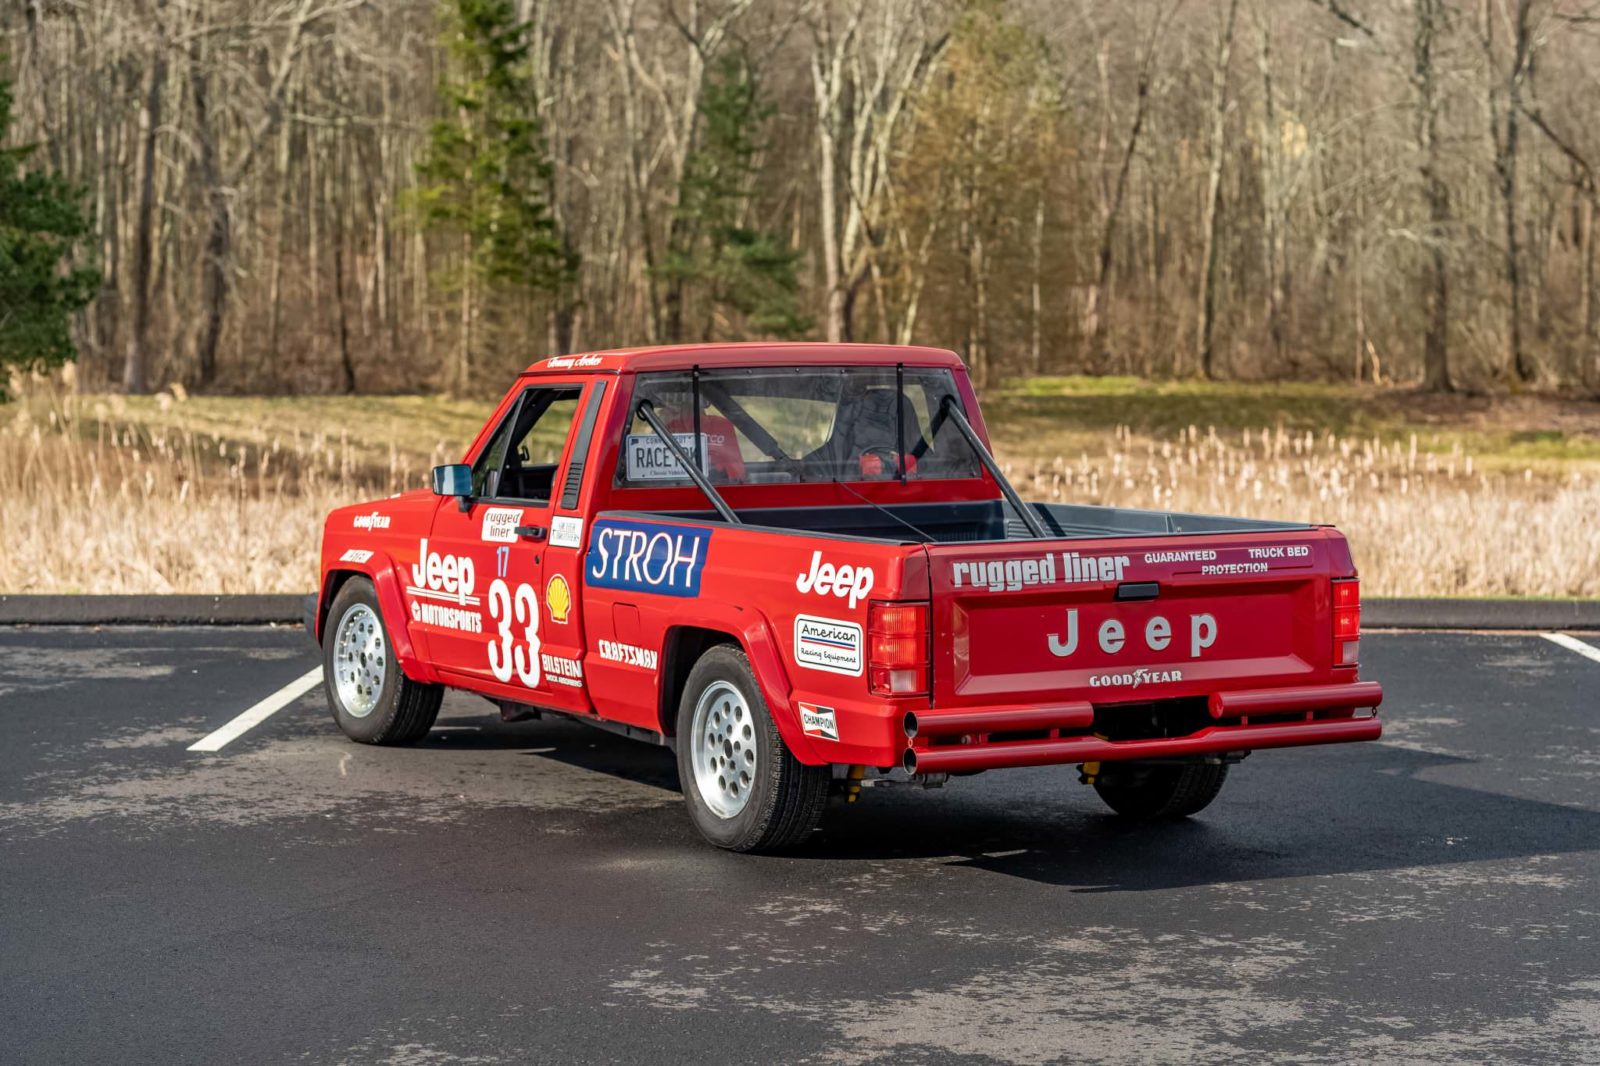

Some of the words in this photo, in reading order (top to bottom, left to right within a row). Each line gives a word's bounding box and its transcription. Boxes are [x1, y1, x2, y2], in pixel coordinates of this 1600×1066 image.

[486, 512, 521, 526] rugged
[490, 525, 511, 538] liner
[496, 546, 510, 578] 17
[592, 527, 701, 588] STROH
[1144, 550, 1217, 564] GUARANTEED
[1248, 547, 1285, 559] TRUCK
[1287, 546, 1309, 557] BED
[412, 538, 475, 606] Jeep
[796, 551, 874, 609] Jeep
[952, 552, 1056, 593] rugged
[1062, 551, 1131, 583] liner
[1201, 562, 1268, 576] PROTECTION
[421, 603, 482, 634] MOTORSPORTS
[487, 578, 541, 689] 33
[801, 624, 856, 643] American
[1046, 608, 1218, 658] Jeep
[541, 653, 583, 678] BILSTEIN
[598, 640, 659, 671] CRAFTSMAN
[801, 647, 822, 660] Racing
[824, 651, 856, 663] Equipment
[1089, 669, 1183, 689] GOODYEAR
[803, 714, 835, 730] CHAMPION
